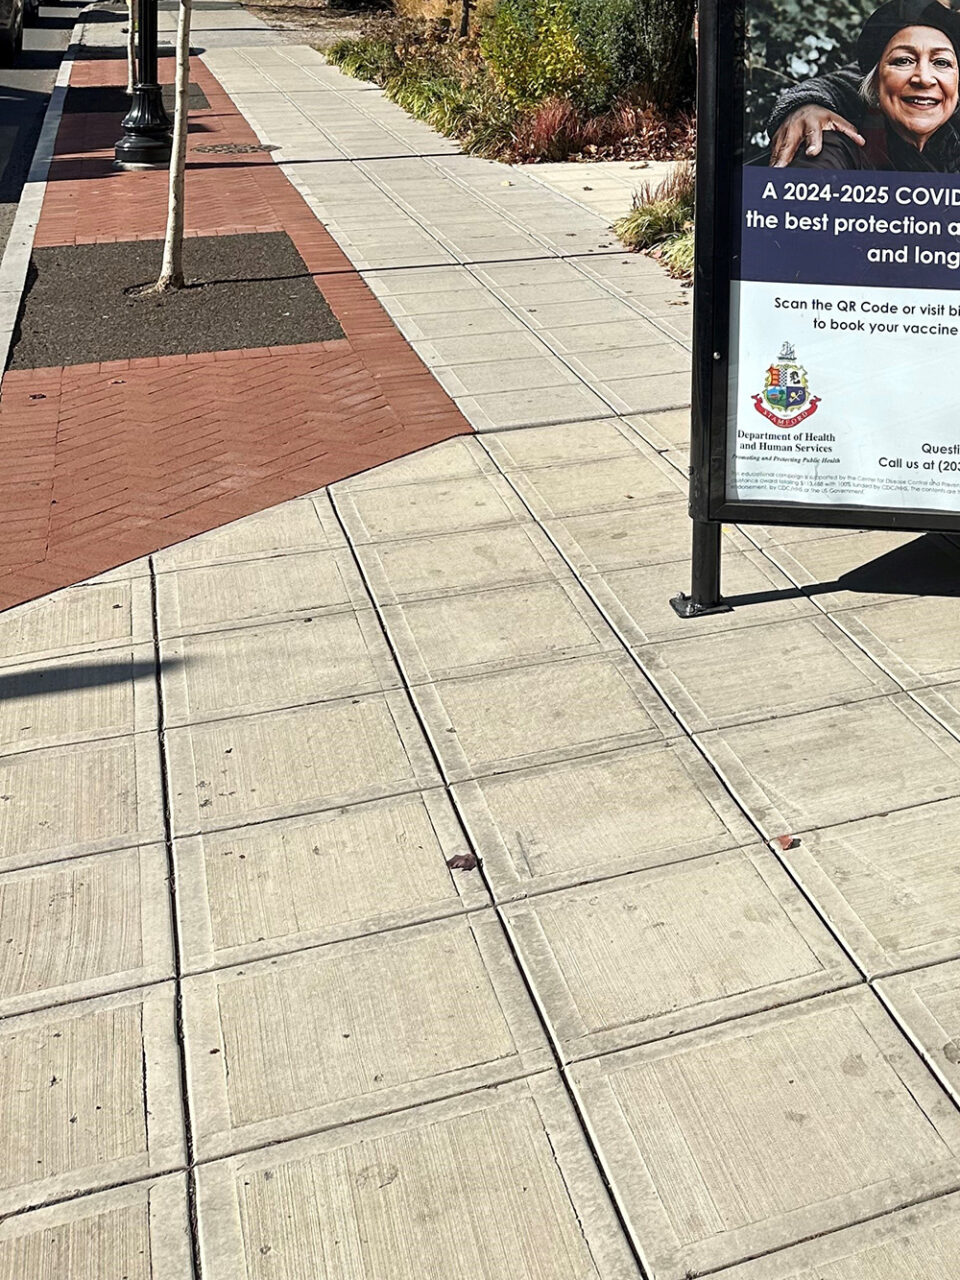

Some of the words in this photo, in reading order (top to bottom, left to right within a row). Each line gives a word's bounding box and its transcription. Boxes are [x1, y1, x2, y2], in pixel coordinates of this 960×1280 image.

[761, 181, 777, 199] A
[782, 182, 888, 203] 2024-2025
[745, 209, 778, 228] the
[784, 211, 828, 230] best
[834, 214, 940, 235] protection
[866, 245, 907, 263] and
[914, 245, 960, 269] long
[774, 296, 807, 309] Scan
[811, 298, 832, 310] the
[836, 300, 856, 312] QR
[860, 301, 898, 314] Code
[902, 305, 915, 314] or
[919, 303, 944, 315] visit
[812, 317, 826, 329] to
[830, 318, 864, 331] book
[868, 322, 898, 334] your
[902, 323, 958, 335] vaccine
[763, 411, 808, 425] STAMFORD
[738, 430, 790, 440] Department
[794, 432, 803, 440] of
[805, 432, 835, 442] Health
[740, 442, 756, 450] and
[760, 443, 792, 451] Human
[795, 444, 832, 452] Services
[878, 457, 902, 468] Call
[906, 461, 919, 469] us
[923, 460, 934, 469] at
